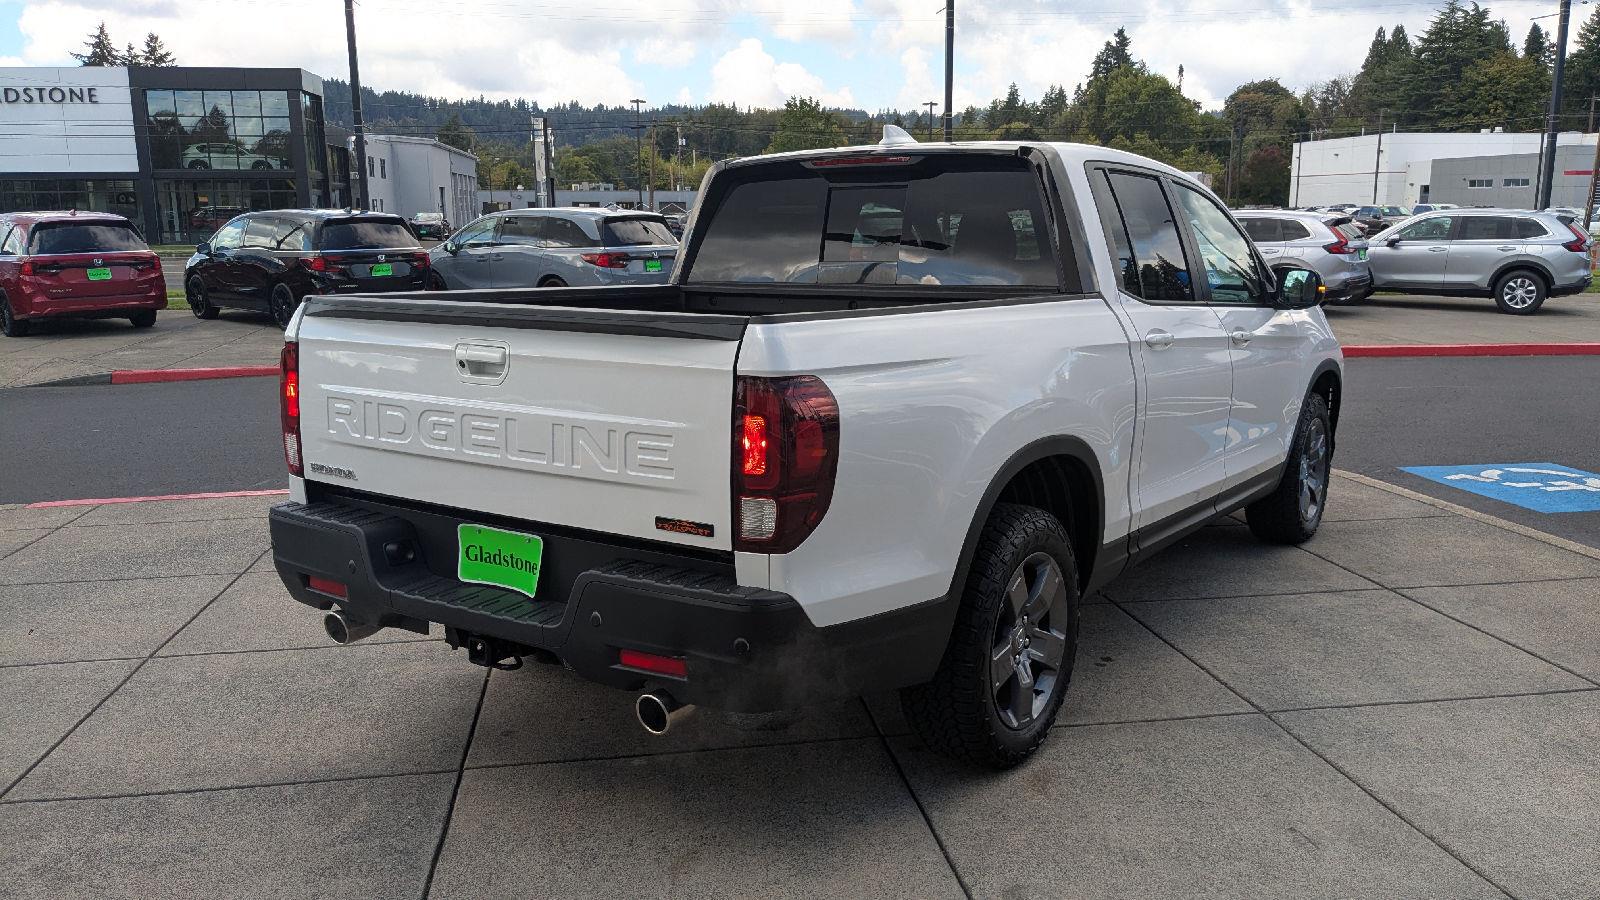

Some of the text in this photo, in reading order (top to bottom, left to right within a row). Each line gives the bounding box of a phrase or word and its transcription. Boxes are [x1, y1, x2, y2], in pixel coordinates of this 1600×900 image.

[0, 87, 99, 103] DSTONE
[327, 396, 676, 480] RIDGELINE
[465, 544, 538, 576] Gladstone
